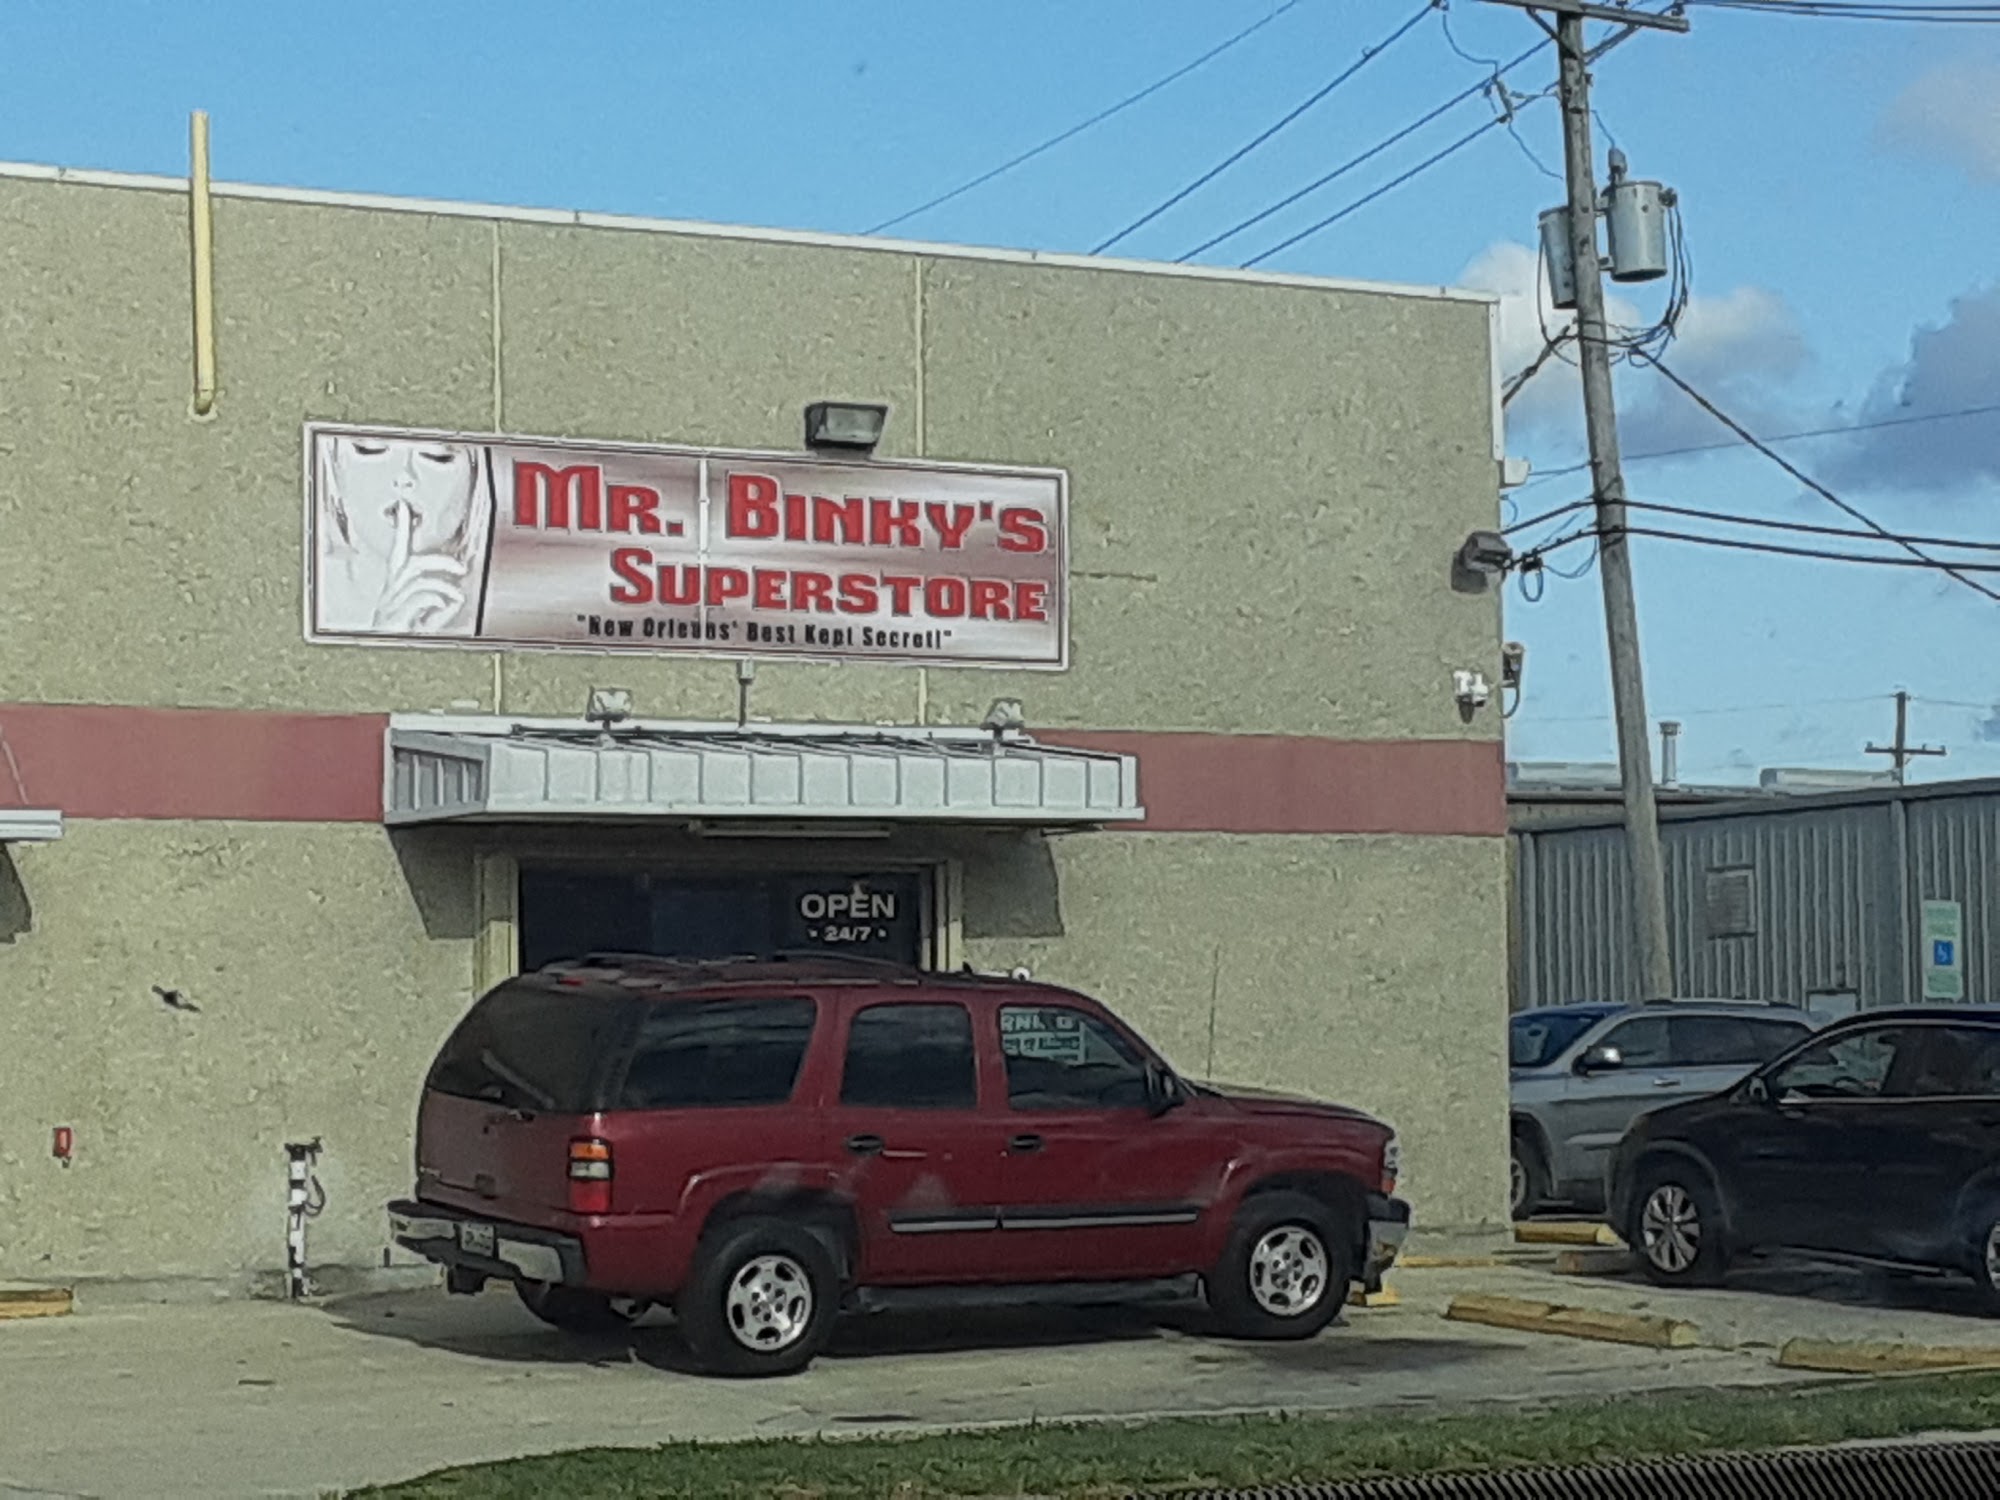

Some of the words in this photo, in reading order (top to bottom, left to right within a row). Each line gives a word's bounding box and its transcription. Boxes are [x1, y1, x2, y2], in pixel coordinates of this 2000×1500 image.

[512, 461, 684, 537] MR.
[725, 471, 1048, 554] BINKY'S
[609, 546, 1048, 623] SUPERSTORE
[577, 614, 634, 637] "New
[746, 621, 796, 644] Best
[805, 623, 854, 648] Kept
[800, 893, 896, 919] OPEN
[823, 925, 872, 942] 24/7
